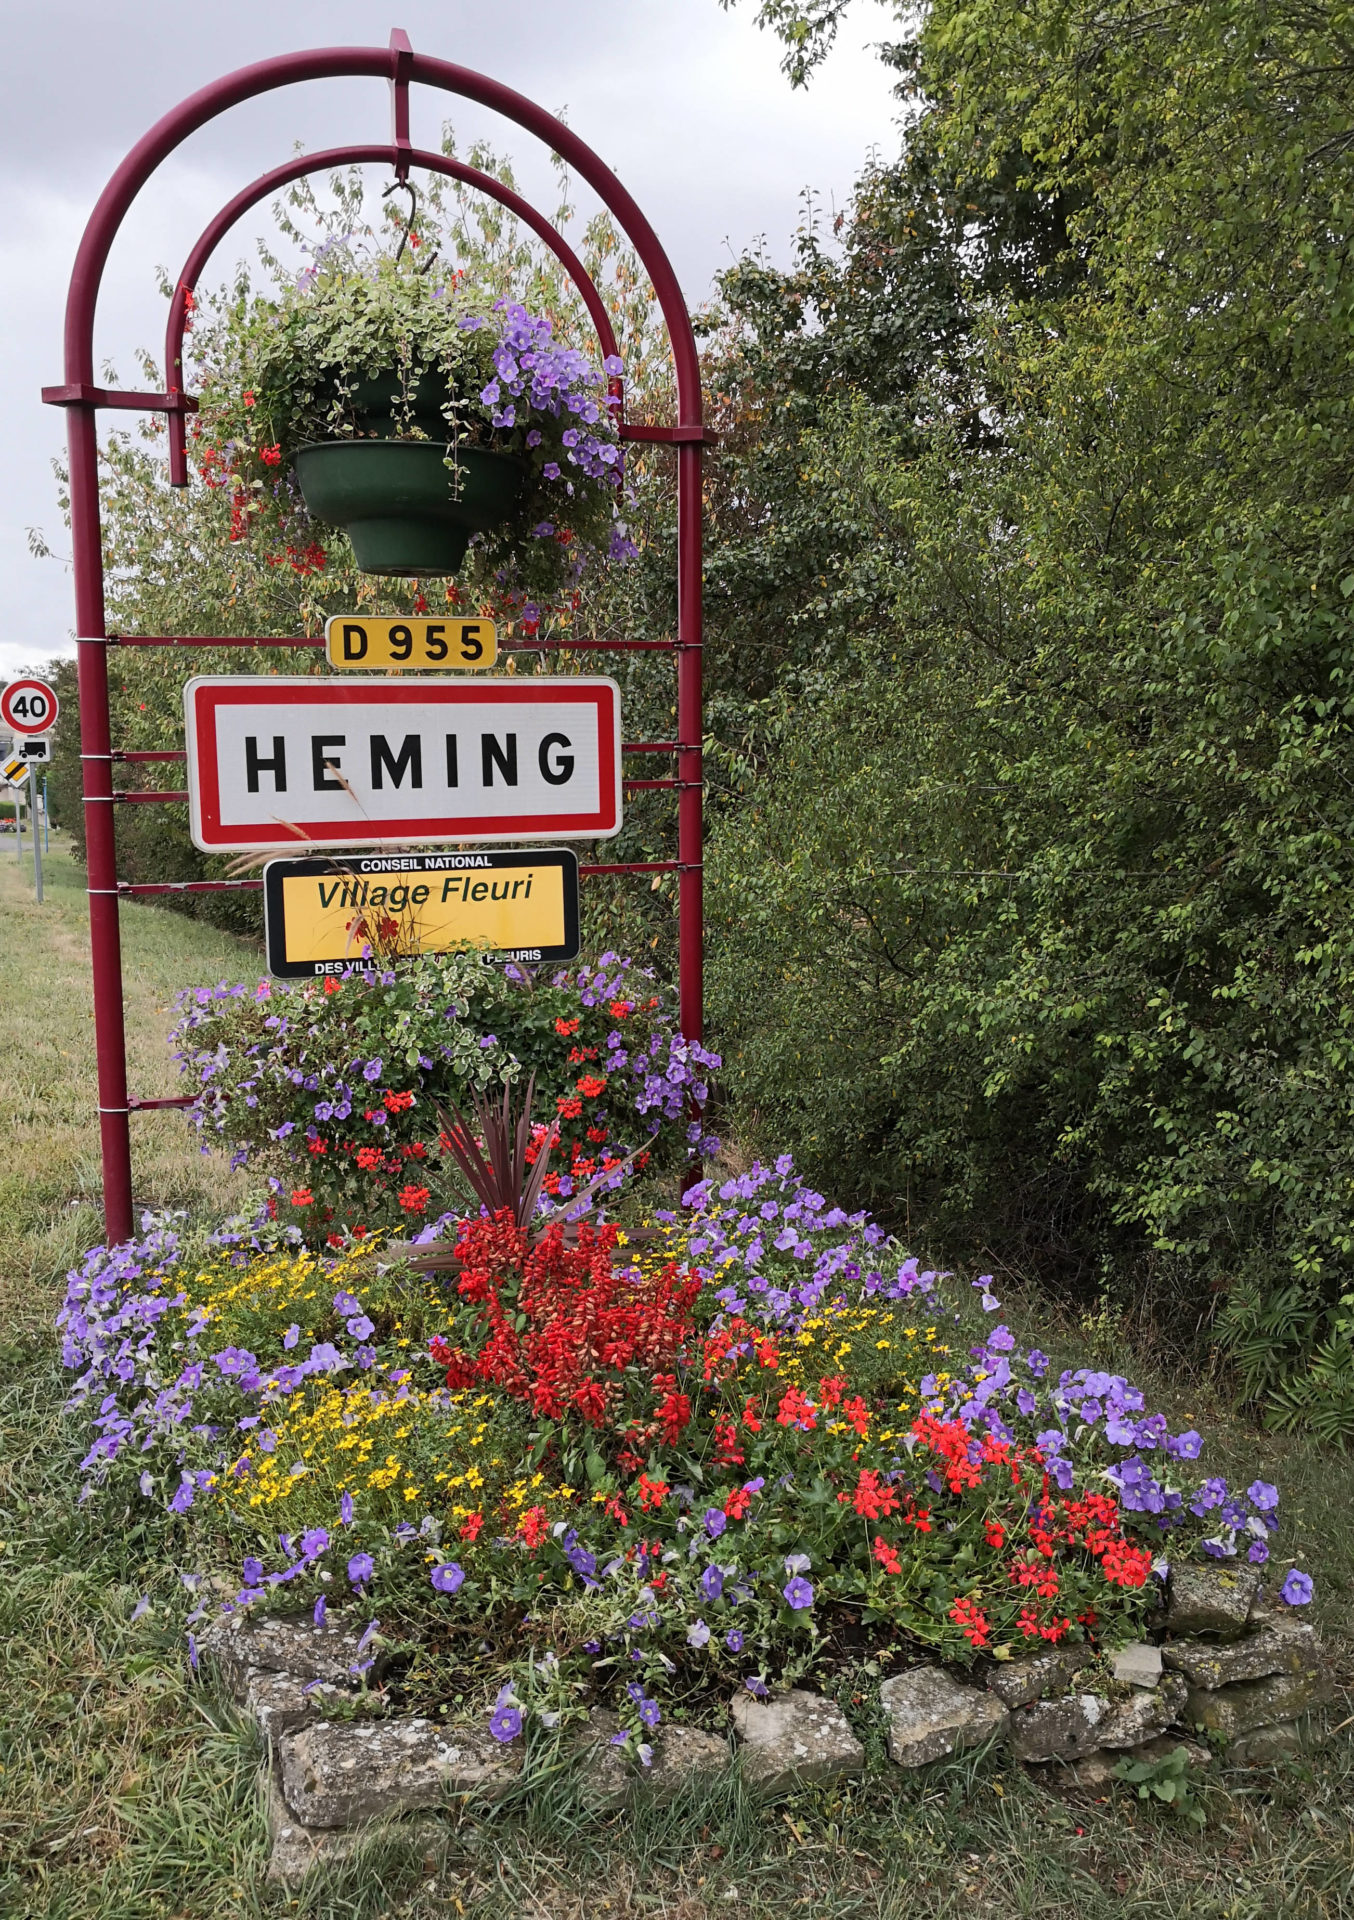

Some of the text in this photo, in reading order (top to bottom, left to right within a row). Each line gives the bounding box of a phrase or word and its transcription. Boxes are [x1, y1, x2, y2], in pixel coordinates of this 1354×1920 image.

[343, 624, 484, 661] D 955
[12, 695, 47, 718] 40
[244, 732, 575, 793] HEMING
[360, 855, 493, 872] CONSEIL NATIONAL
[317, 873, 534, 913] Village Fleuri
[314, 962, 344, 975] DES
[345, 960, 381, 973] VILL
